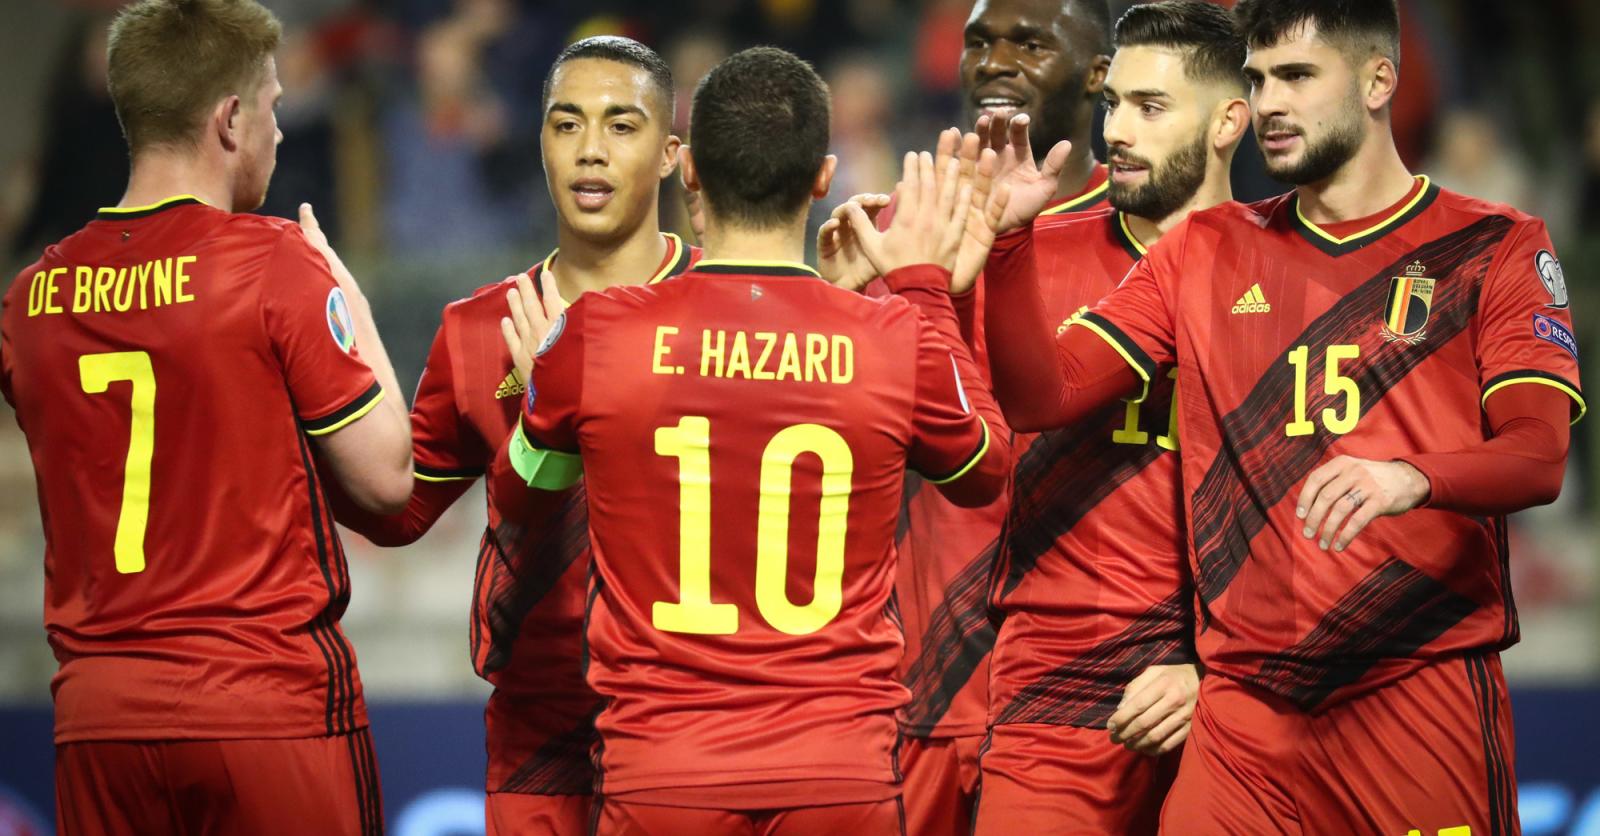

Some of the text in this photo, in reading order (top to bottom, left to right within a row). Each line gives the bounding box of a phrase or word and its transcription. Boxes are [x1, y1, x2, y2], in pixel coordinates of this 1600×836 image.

[28, 256, 197, 317] DE BRUYNE
[1231, 303, 1271, 315] adidas
[652, 326, 854, 384] E. HAZARD
[494, 383, 525, 400] adida
[1285, 344, 1361, 437] 15
[78, 351, 157, 574] 7
[652, 416, 854, 635] 10
